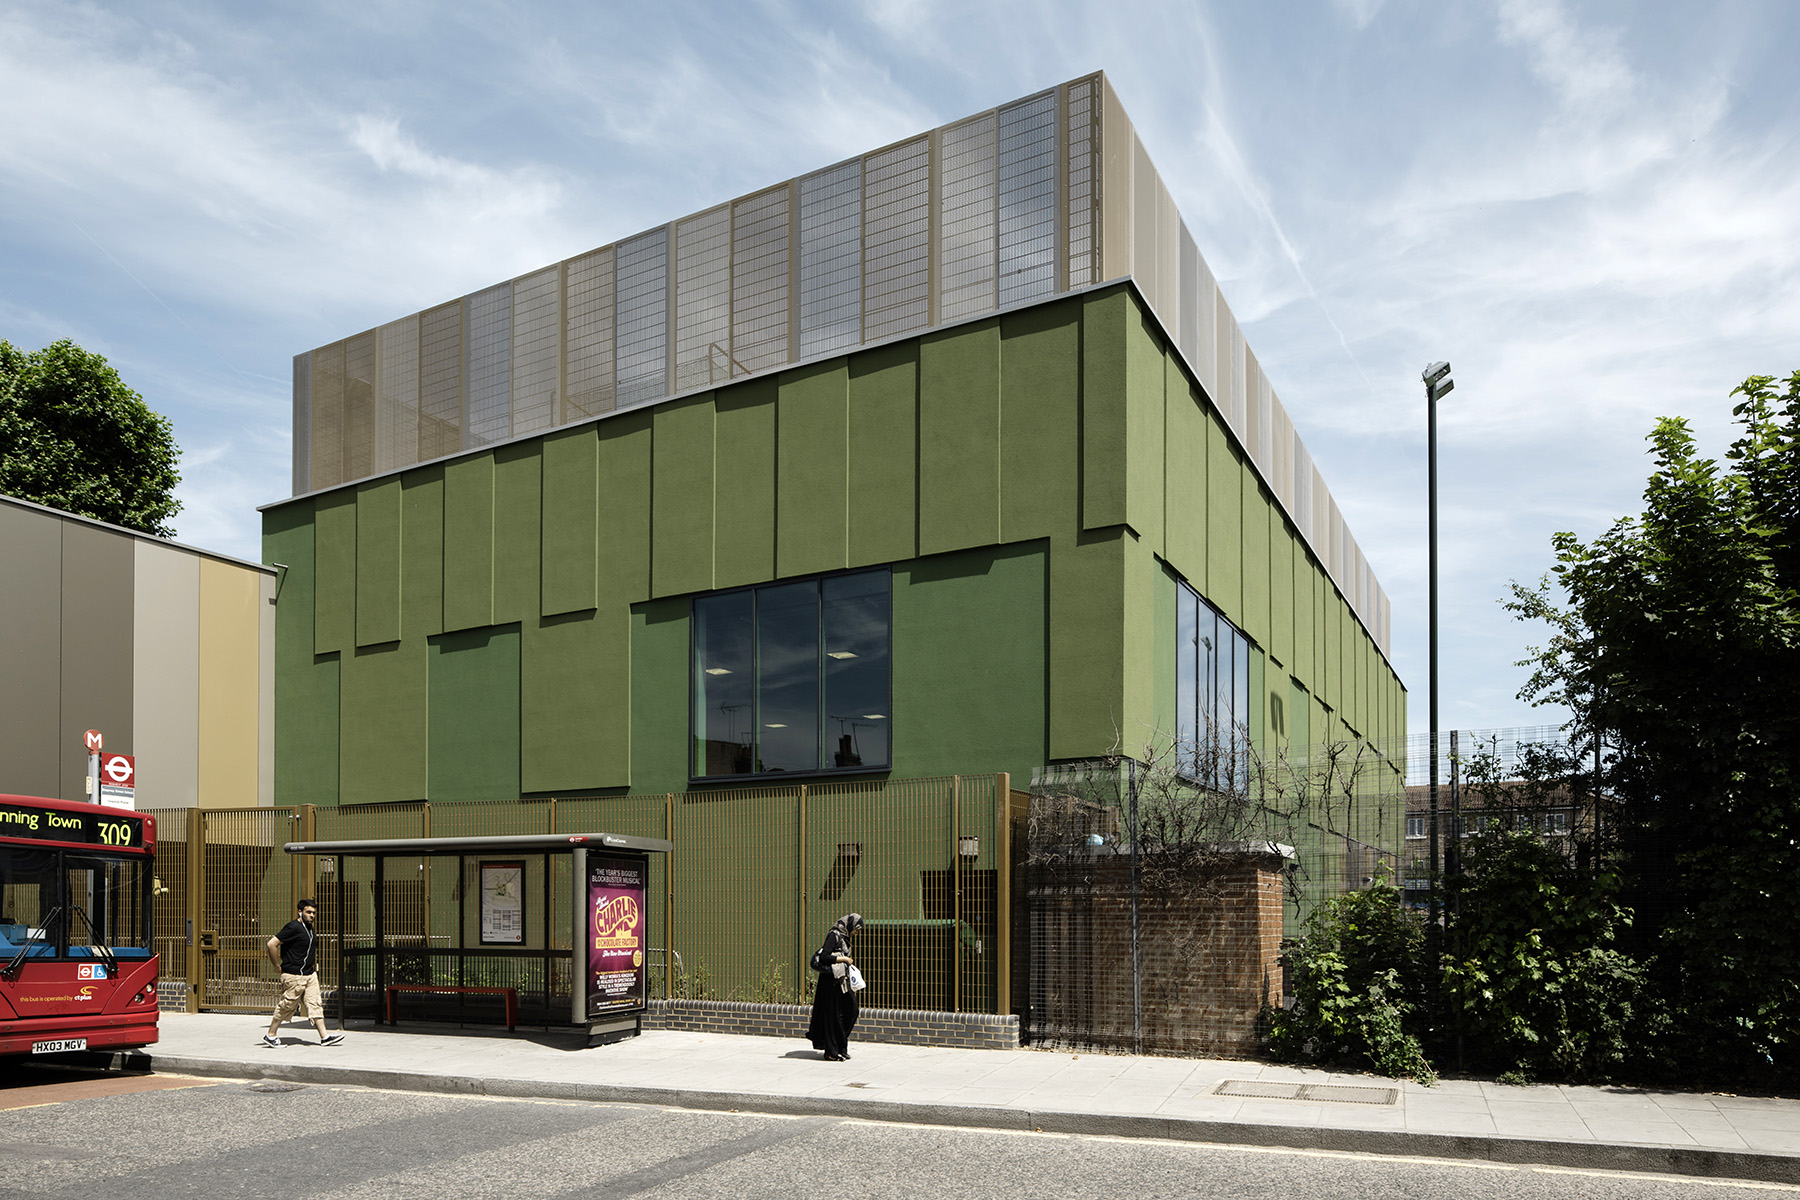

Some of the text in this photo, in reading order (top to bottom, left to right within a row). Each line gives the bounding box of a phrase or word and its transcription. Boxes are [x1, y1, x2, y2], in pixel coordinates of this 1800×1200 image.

[87, 732, 102, 749] M
[45, 812, 82, 829] Town
[98, 822, 131, 846] 309
[592, 875, 622, 884] BLOCKBUSTER
[597, 897, 636, 934] CHARLIE
[67, 994, 73, 1002] by
[36, 1040, 83, 1052] HX03 MGV
